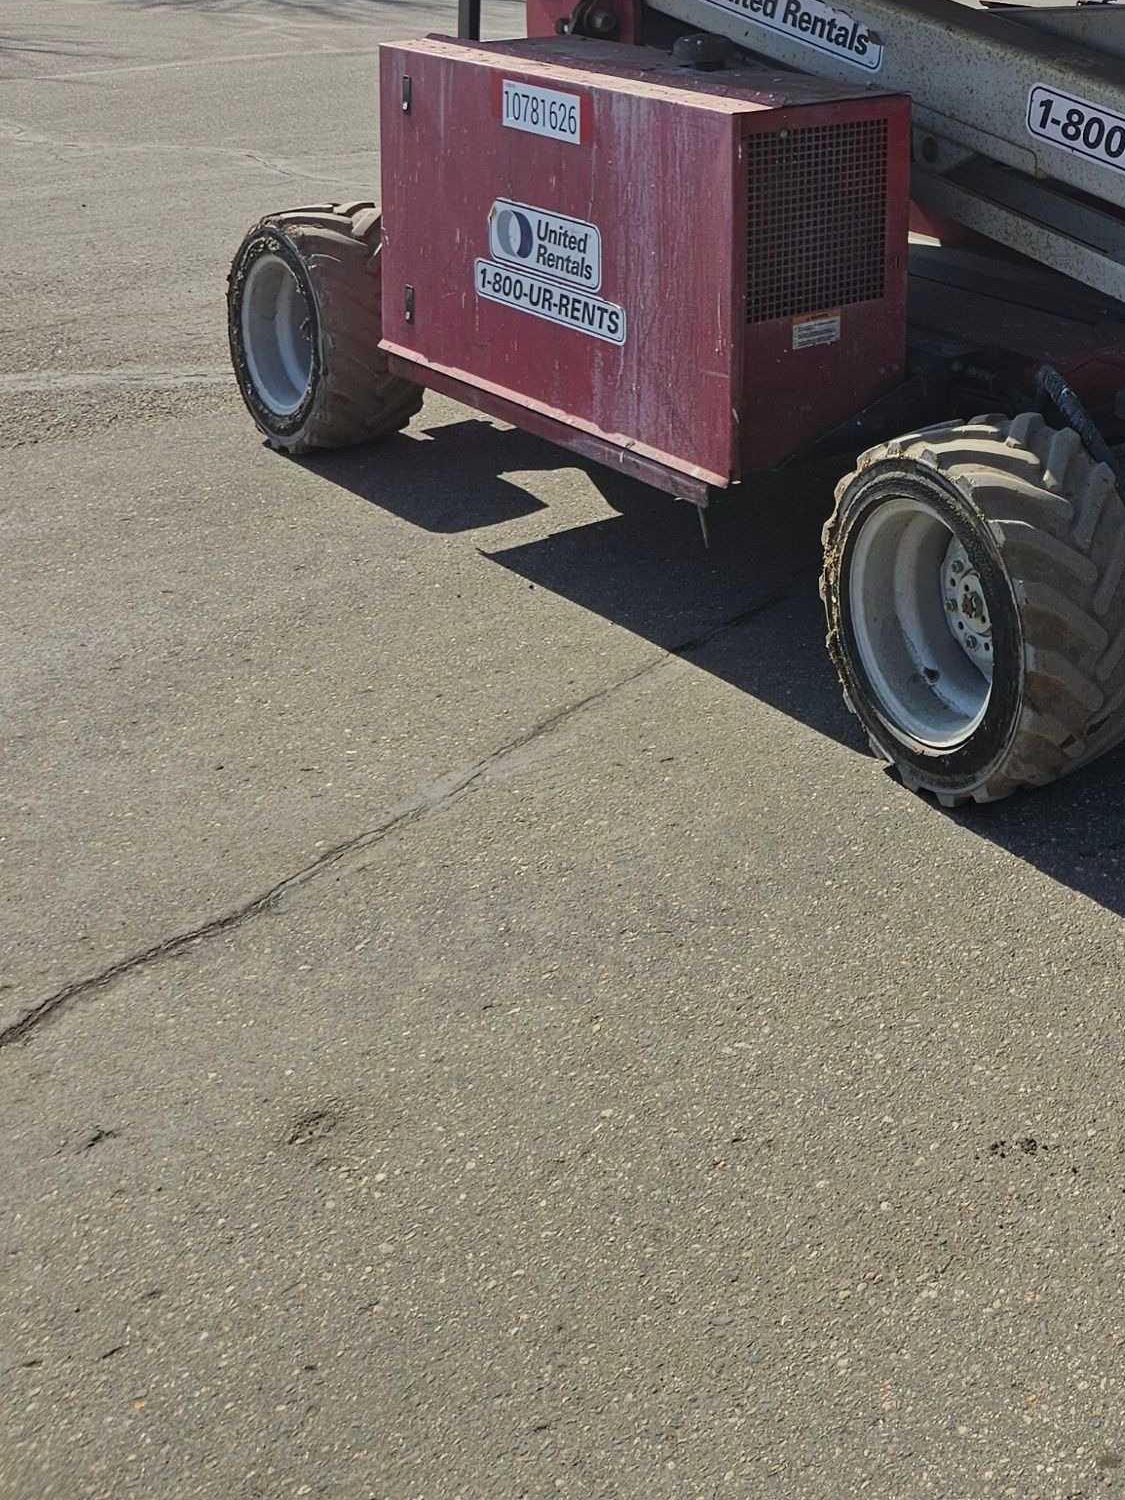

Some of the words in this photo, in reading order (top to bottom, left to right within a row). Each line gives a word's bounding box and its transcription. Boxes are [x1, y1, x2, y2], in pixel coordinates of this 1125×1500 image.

[505, 91, 577, 135] 10781626
[536, 219, 588, 254] United
[536, 245, 593, 280] Rentals
[480, 268, 621, 335] 1-800-UR-RENTS
